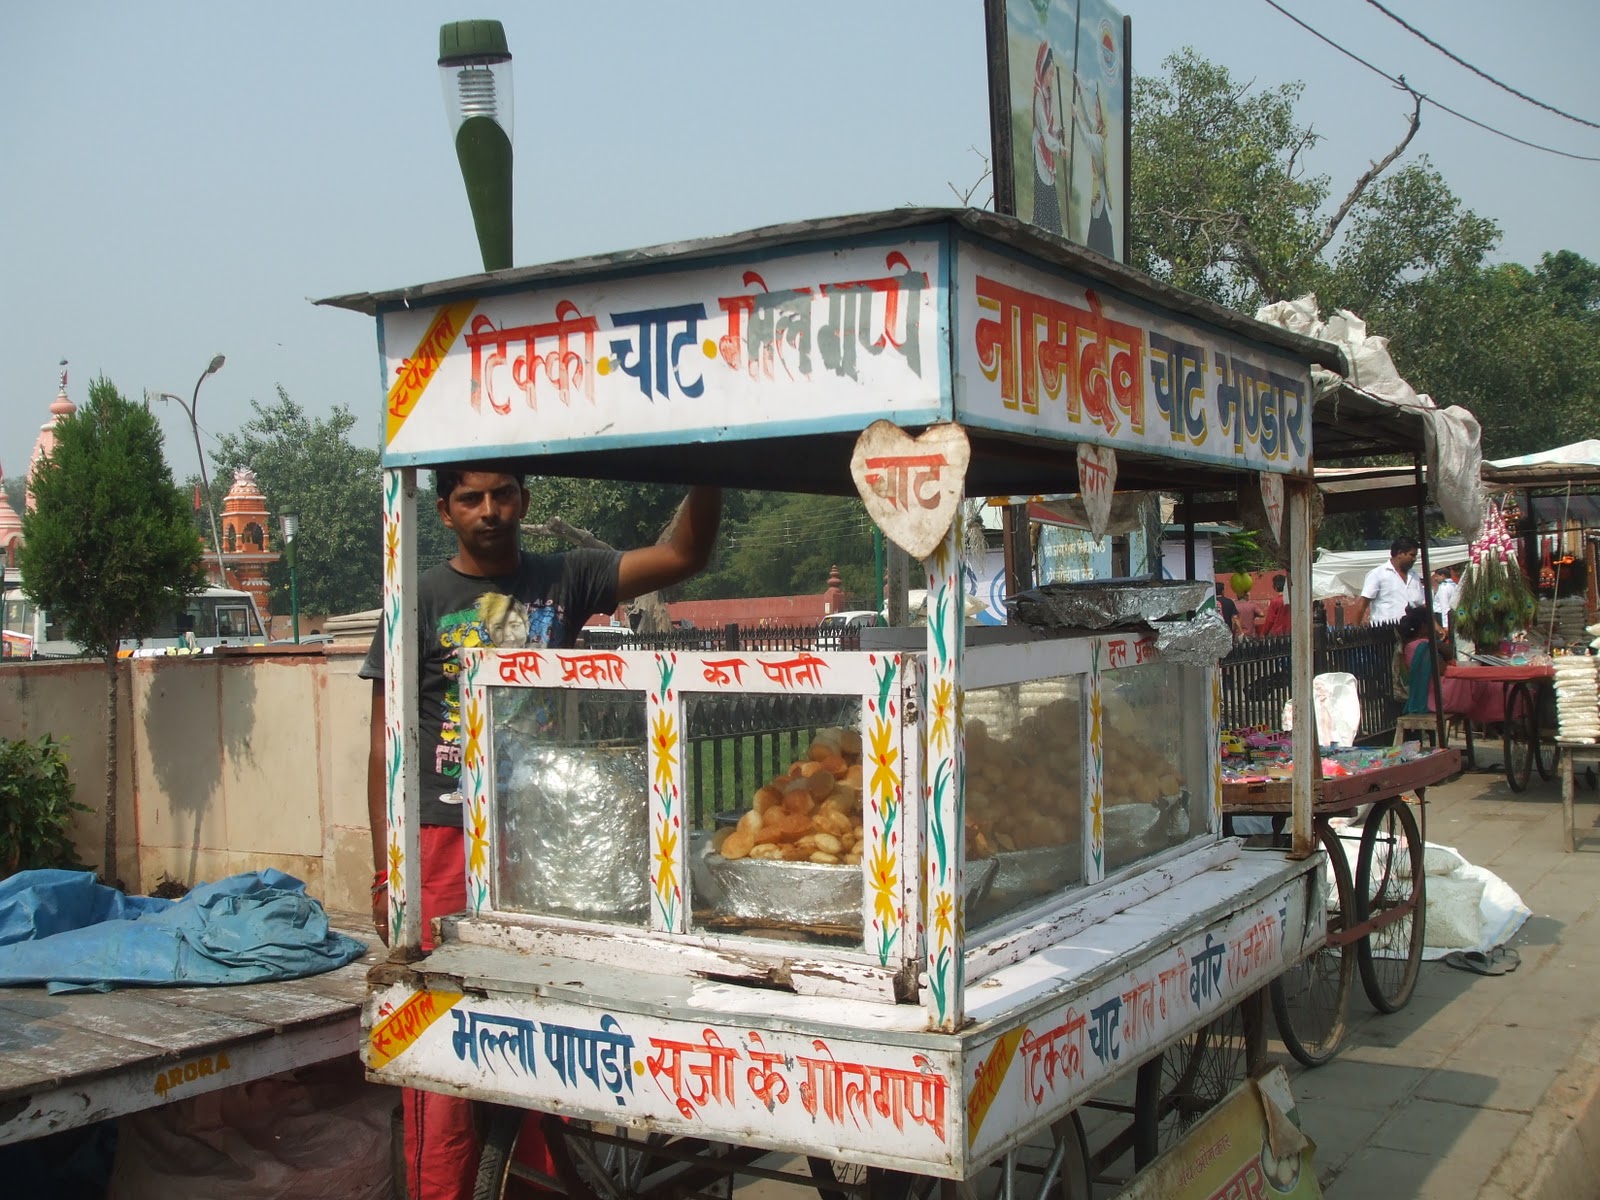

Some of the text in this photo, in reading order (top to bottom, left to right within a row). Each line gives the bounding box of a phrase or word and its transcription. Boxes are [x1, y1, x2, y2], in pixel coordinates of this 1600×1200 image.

[464, 300, 600, 416] टिक्की
[609, 302, 708, 404] चाट
[975, 274, 1147, 438] नामदेव
[1149, 330, 1209, 447] चाट
[864, 453, 949, 513] चाट
[496, 650, 549, 686] दस
[555, 652, 632, 688] प्रकार
[701, 657, 752, 688] का
[1108, 640, 1127, 668] दस
[154, 1050, 231, 1100] ARORA
[450, 1008, 539, 1080] भल्ला
[540, 1003, 637, 1107] पापड़ी
[646, 1028, 744, 1123] सूजी
[746, 1031, 791, 1115] के
[1019, 1006, 1088, 1109] टिक्की
[1088, 996, 1123, 1065] चाट
